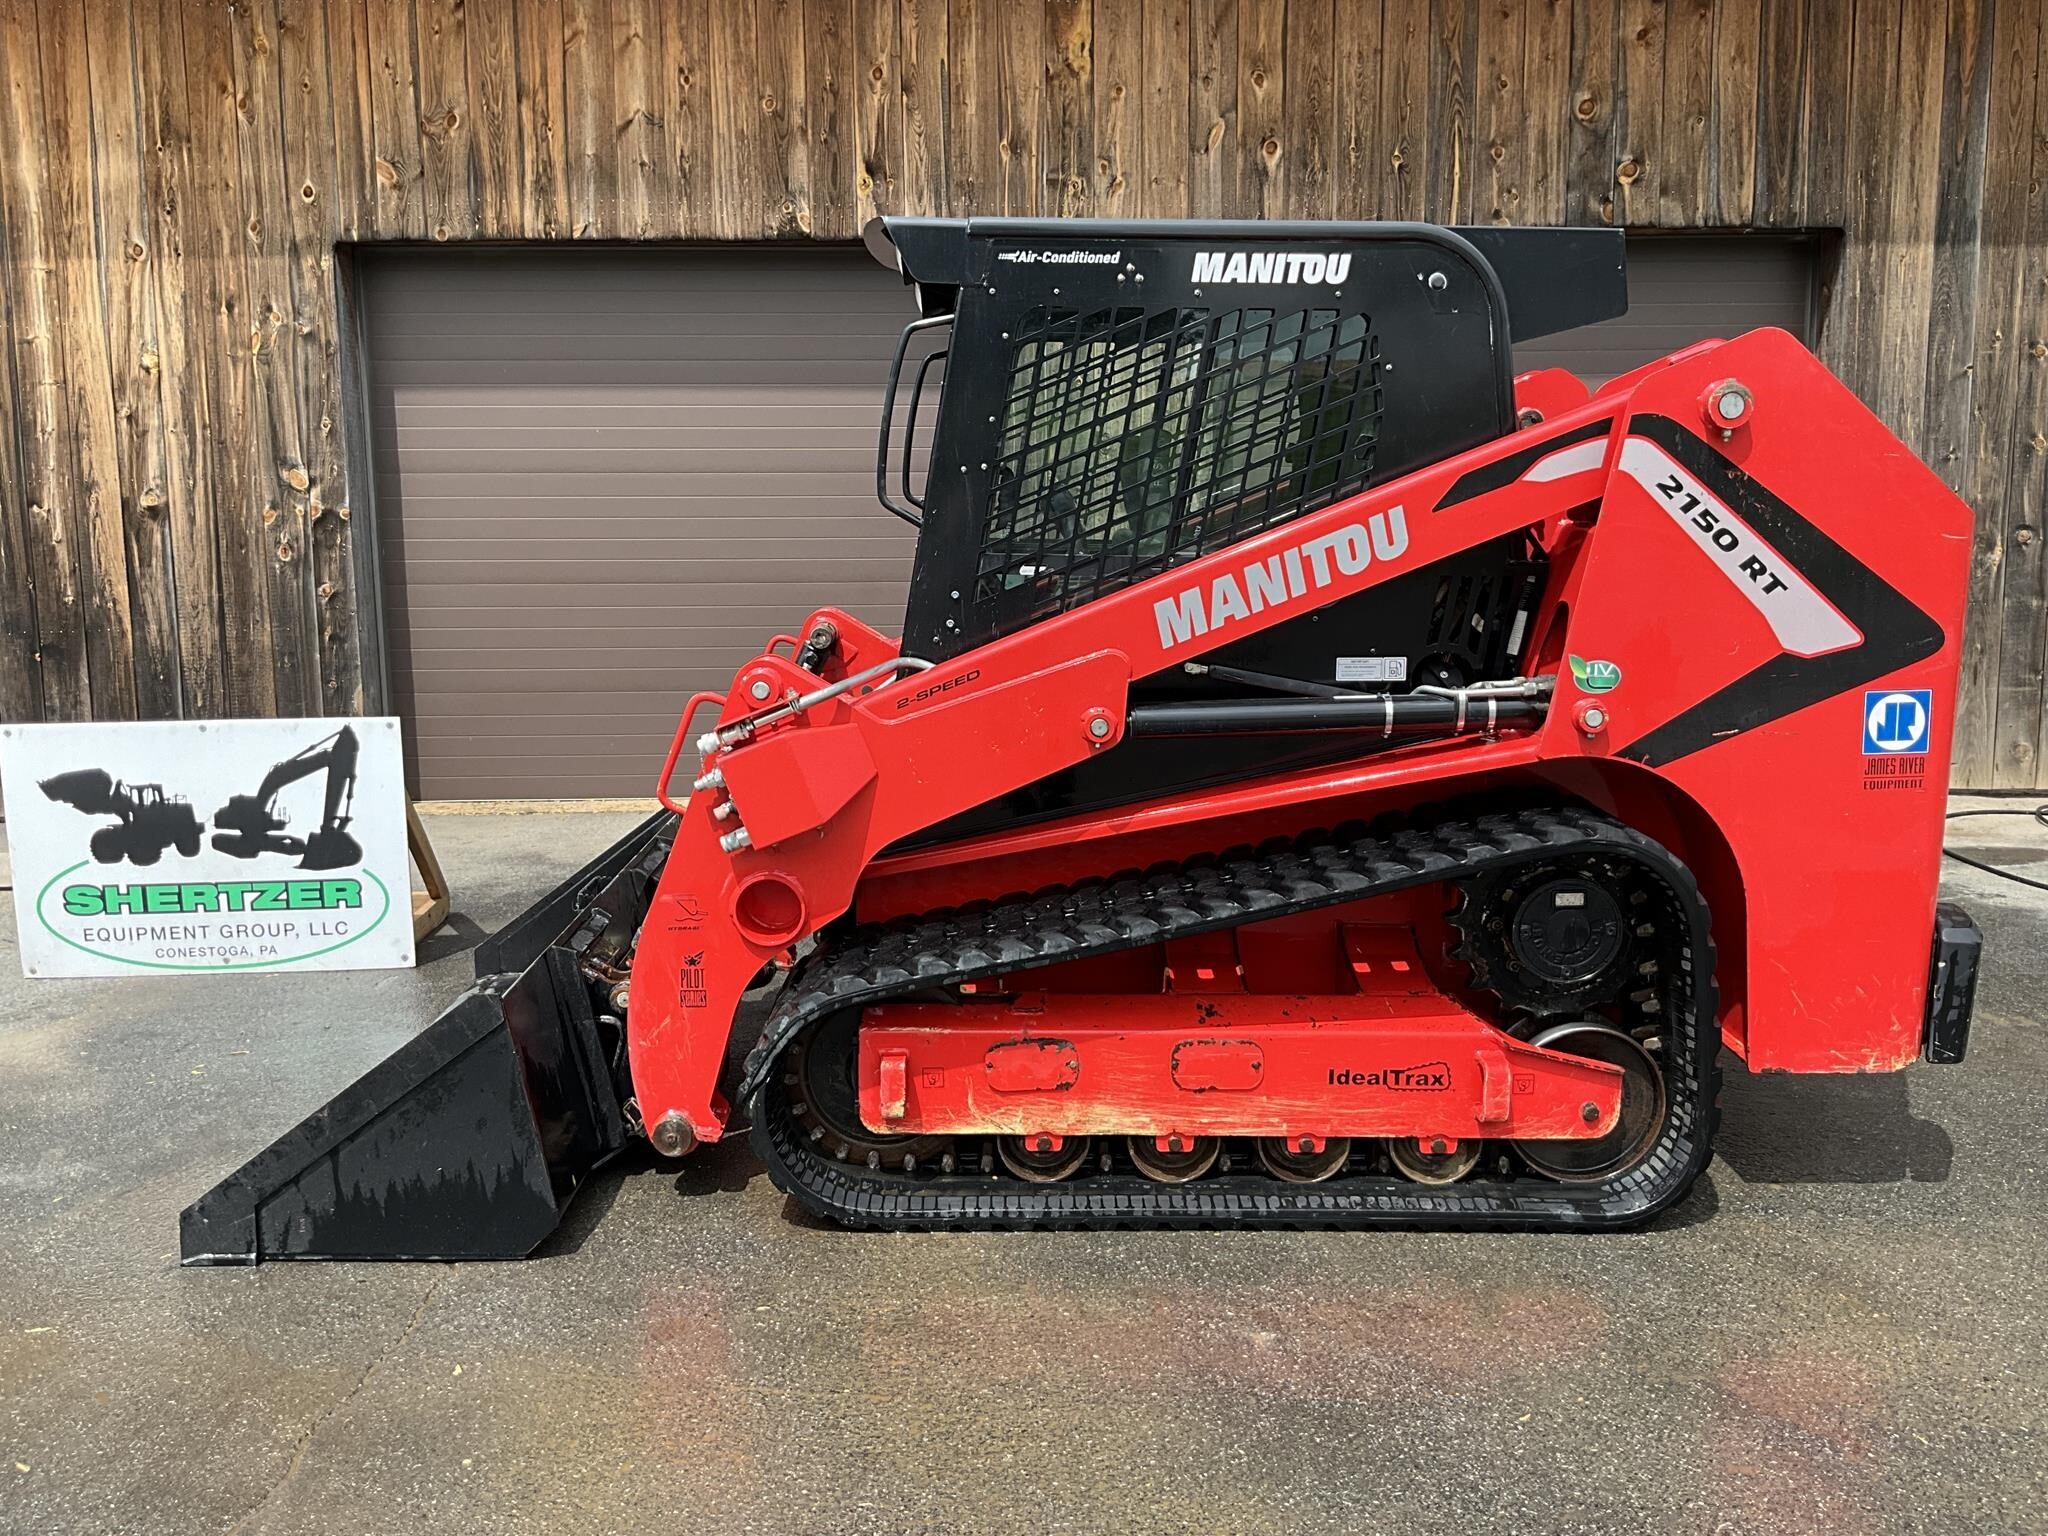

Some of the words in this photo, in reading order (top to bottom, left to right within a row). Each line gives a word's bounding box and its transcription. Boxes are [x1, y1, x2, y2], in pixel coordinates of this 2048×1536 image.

[1017, 250, 1121, 264] Air-Conditioned
[1191, 252, 1351, 284] MANITOU
[1656, 474, 1739, 552] 2150
[1738, 554, 1789, 595] RT
[1153, 504, 1410, 650] MANITOU
[896, 669, 980, 710] 2-SPEED
[1876, 702, 1916, 741] JR
[1864, 757, 1896, 775] JAMES
[1899, 756, 1925, 774] RIVER
[1863, 779, 1923, 790] EQUIPMENT
[63, 879, 362, 916] SHERTZER
[83, 925, 210, 942] EQUIPMENT
[219, 922, 300, 939] GROUP,
[309, 921, 349, 936] LLC
[155, 946, 254, 959] CONESTOGA,
[259, 945, 278, 956] PA
[680, 968, 704, 989] PILOT
[1328, 1069, 1446, 1087] IdealTrax
